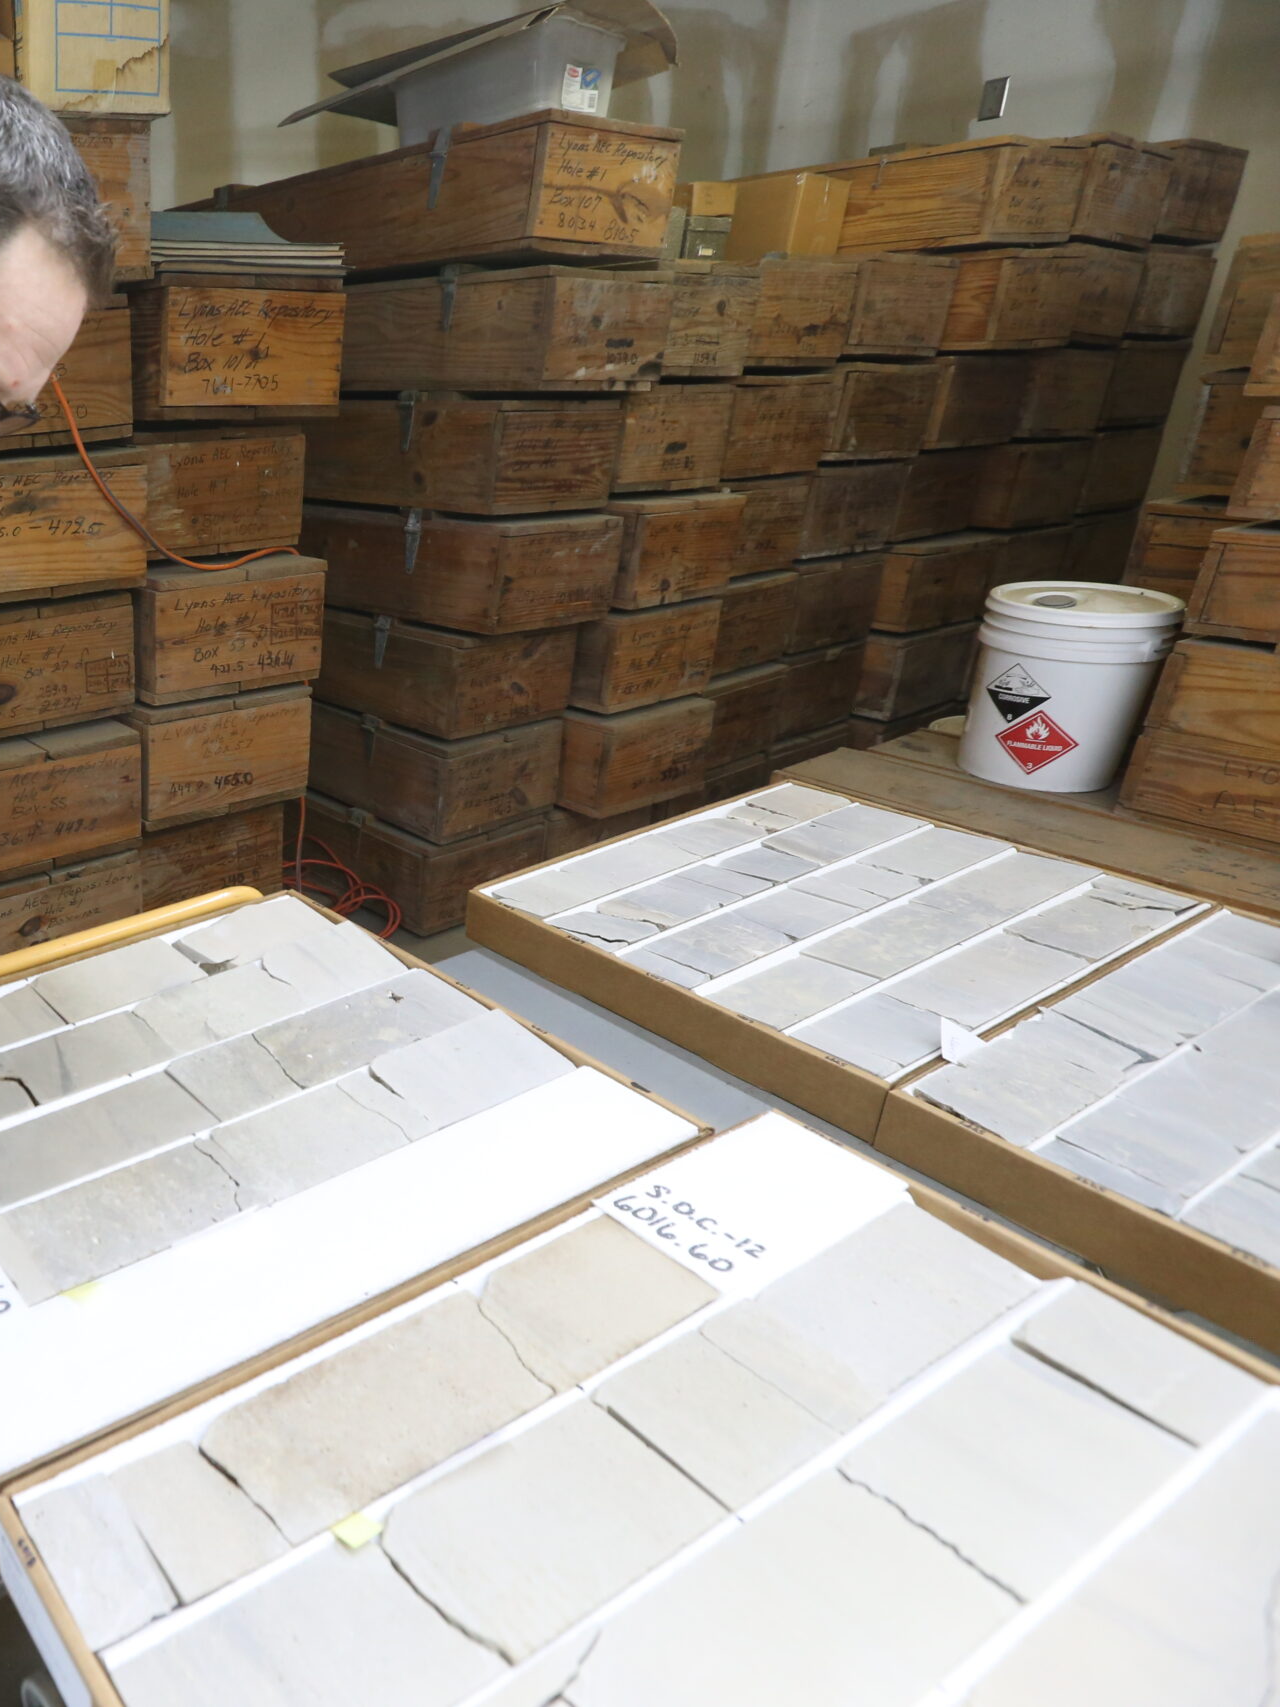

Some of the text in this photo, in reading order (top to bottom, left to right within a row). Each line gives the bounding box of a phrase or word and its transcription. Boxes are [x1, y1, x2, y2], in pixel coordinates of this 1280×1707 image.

[557, 159, 584, 178] Hole
[257, 298, 335, 329] Repository
[184, 326, 225, 347] Hole
[184, 352, 216, 374] Box
[0, 650, 30, 670] Hole
[1006, 739, 1063, 753] FLAMMABLE LIQUID
[612, 1195, 735, 1273] 6016.60
